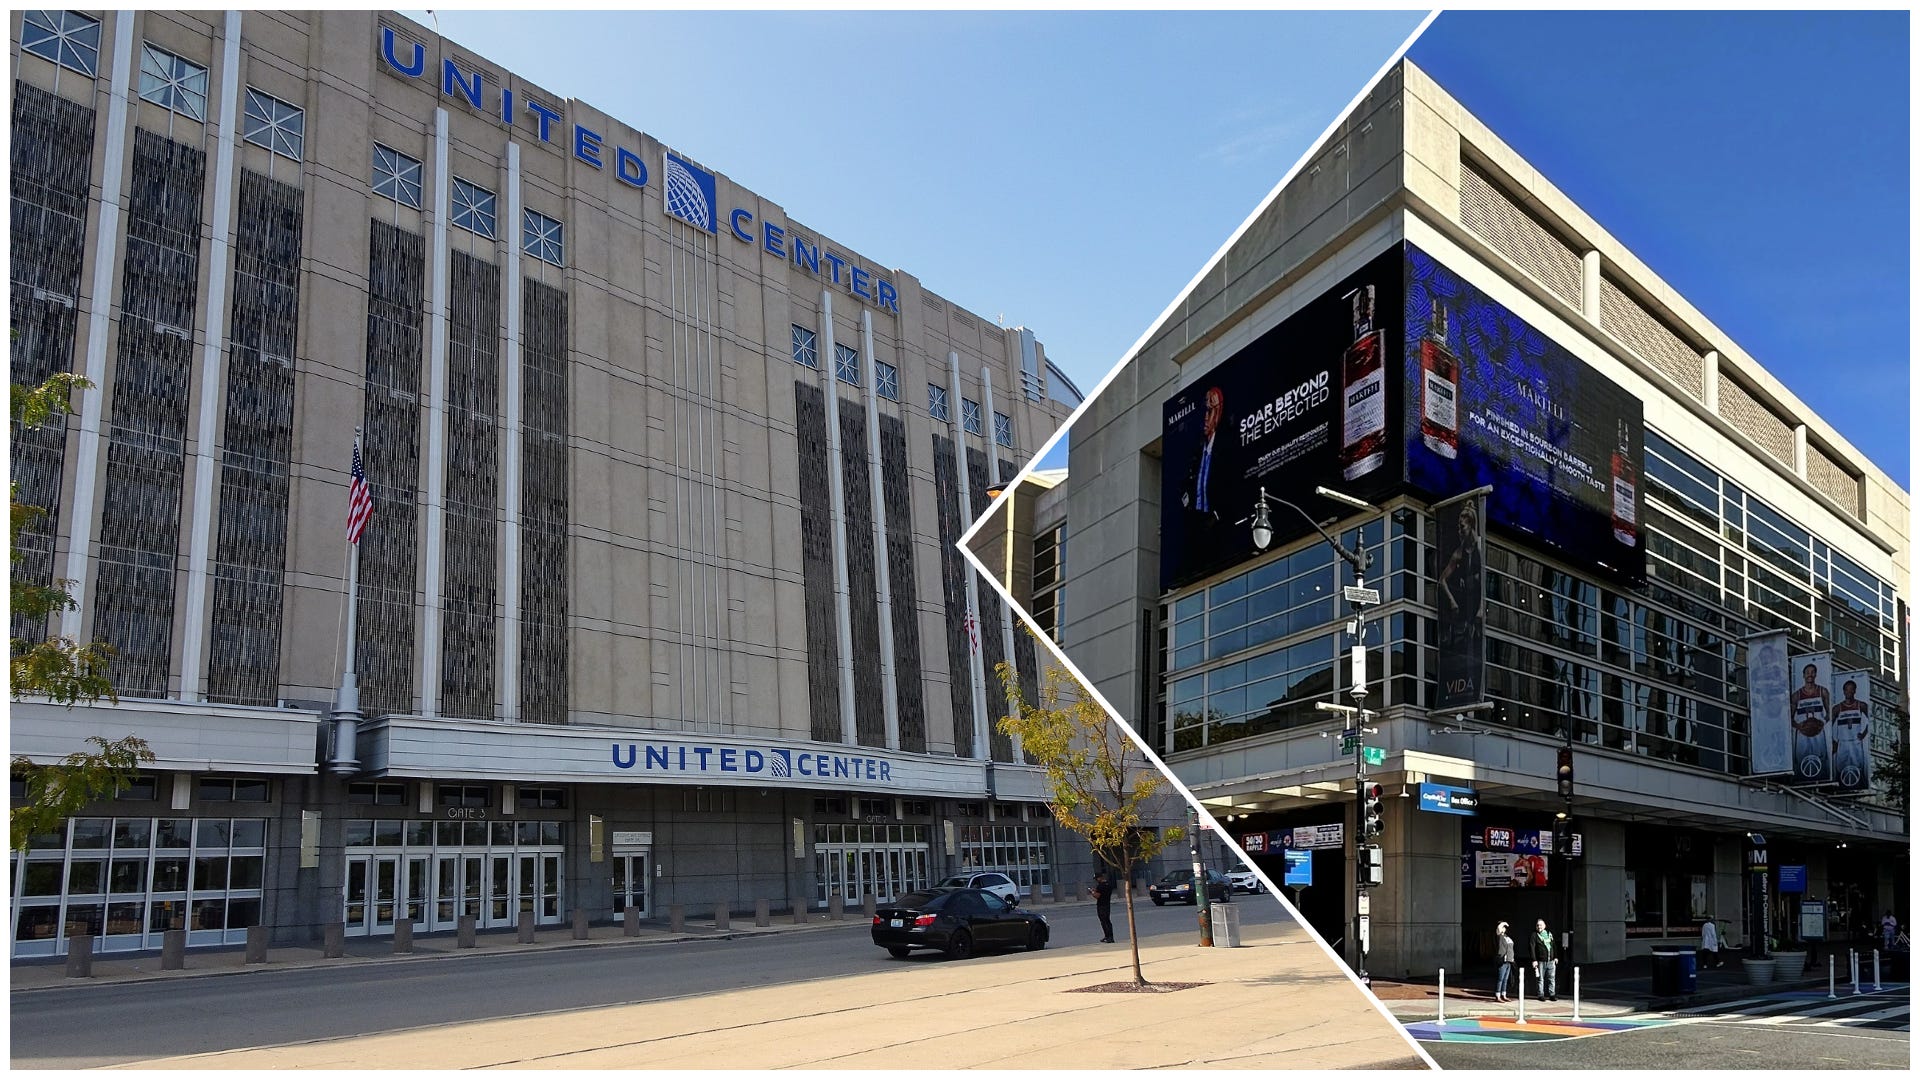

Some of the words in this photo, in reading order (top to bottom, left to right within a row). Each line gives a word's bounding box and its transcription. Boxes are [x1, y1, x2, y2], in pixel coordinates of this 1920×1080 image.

[382, 26, 648, 188] UNITED
[729, 207, 899, 313] CENTER
[1240, 403, 1273, 433] SOAR
[1275, 370, 1329, 413] BEYOND
[1240, 424, 1262, 447] THE
[1264, 386, 1329, 434] EXPECTED
[1469, 411, 1486, 429] FOR
[1487, 420, 1500, 437] AN
[1500, 427, 1558, 466] EXCEPTIONALLY
[1558, 461, 1586, 482] SMOOTH
[1586, 475, 1606, 493] TASTE
[1485, 408, 1520, 433] FINISHED
[1521, 428, 1529, 441] IN
[1529, 432, 1562, 458] BOURBON
[1564, 451, 1593, 474] BARRELS
[1446, 677, 1474, 694] VIDA
[612, 744, 764, 773] UNITED
[797, 753, 891, 782] CENTER
[448, 808, 475, 819] GATE
[479, 808, 486, 819] 3
[1490, 830, 1509, 841] 50/50
[1490, 839, 1509, 848] RAFFLE
[1753, 849, 1767, 864] M
